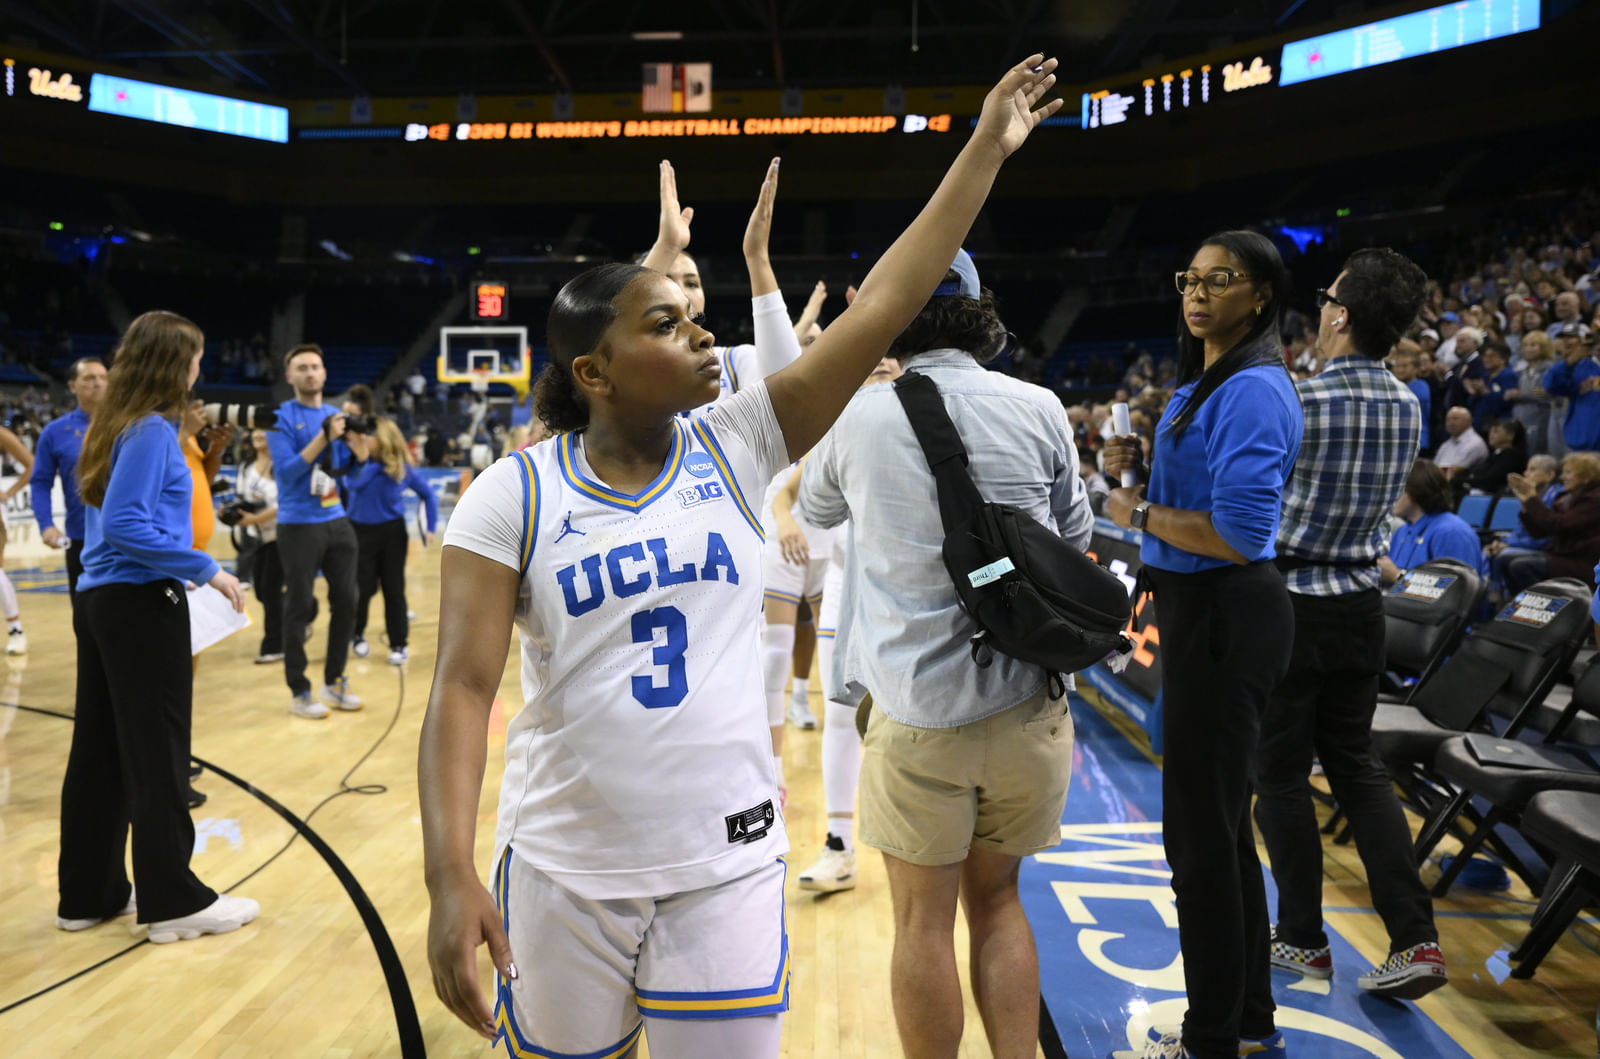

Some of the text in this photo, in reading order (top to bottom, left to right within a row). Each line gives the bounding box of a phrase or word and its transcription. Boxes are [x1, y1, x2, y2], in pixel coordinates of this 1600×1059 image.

[536, 121, 621, 138] WOMEN'S
[624, 119, 740, 137] BASKETBALL
[744, 116, 896, 134] CHAMPIONSHIP
[478, 295, 502, 317] 30
[689, 462, 714, 472] NCAA
[556, 532, 739, 618] UCLA
[631, 605, 689, 709] 3
